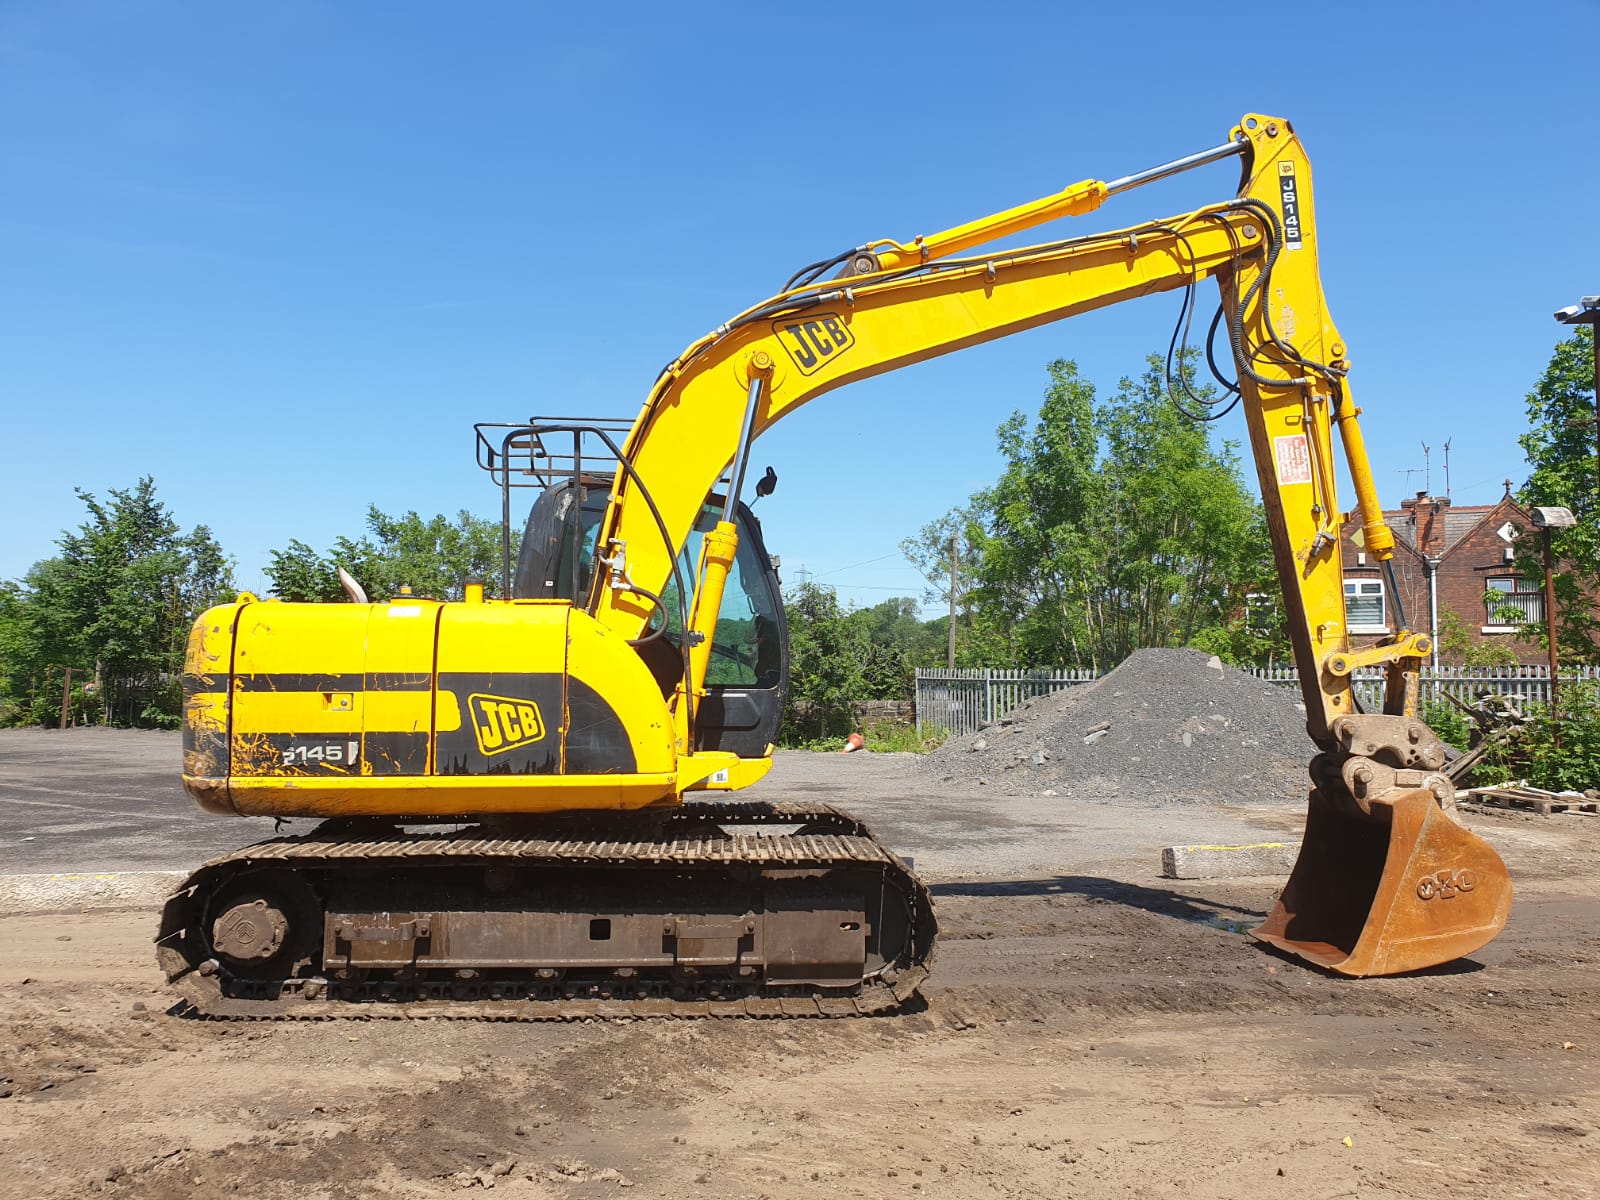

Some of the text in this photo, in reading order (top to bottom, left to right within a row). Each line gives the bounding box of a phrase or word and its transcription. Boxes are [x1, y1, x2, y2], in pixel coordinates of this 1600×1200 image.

[1282, 179, 1299, 239] JS145
[784, 319, 848, 368] JCB
[479, 700, 539, 748] JCB
